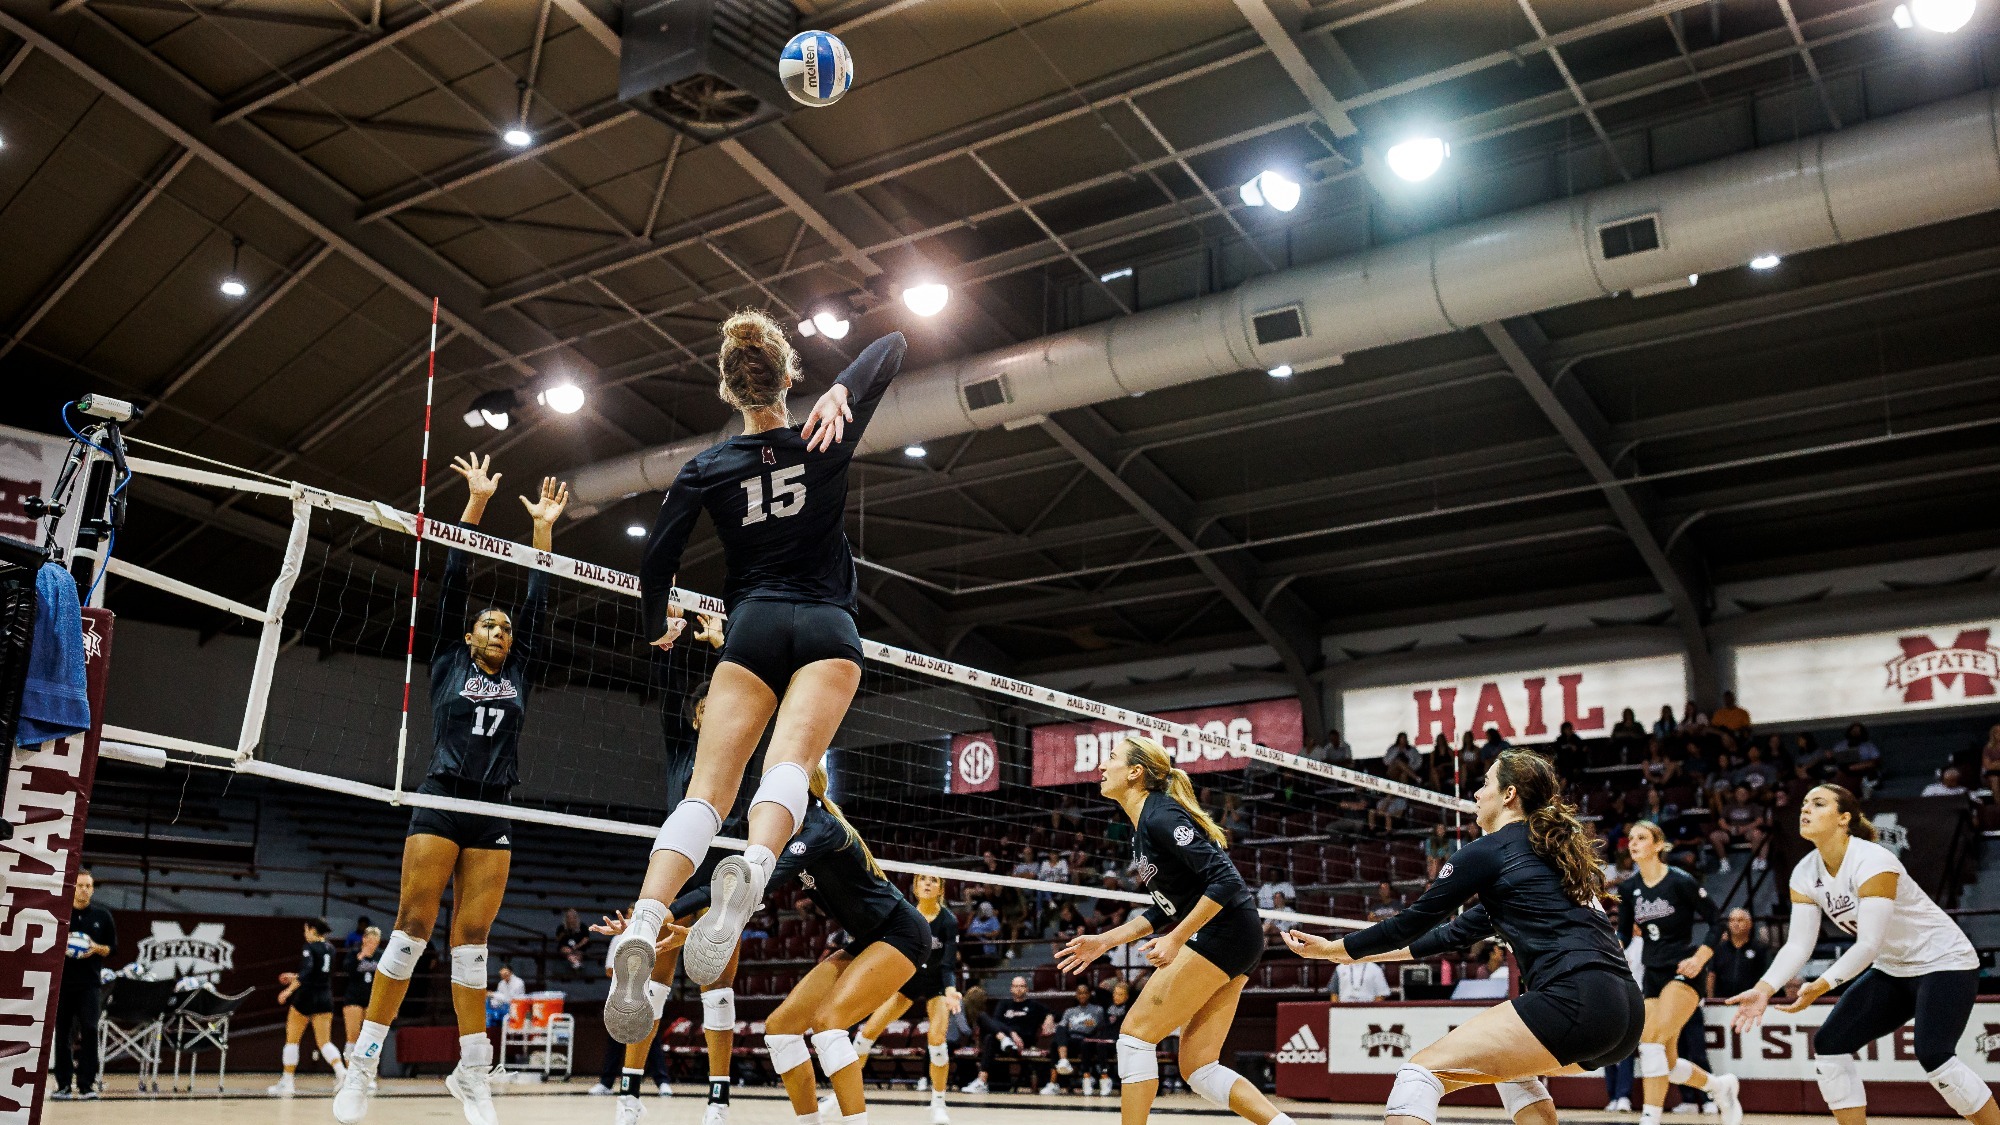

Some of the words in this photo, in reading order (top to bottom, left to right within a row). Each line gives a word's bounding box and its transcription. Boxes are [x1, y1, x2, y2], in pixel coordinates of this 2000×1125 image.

[806, 45, 818, 88] molten
[740, 463, 807, 527] 15
[429, 520, 466, 544] HAIL
[469, 532, 513, 558] STATE
[575, 560, 605, 582] HAIL
[699, 595, 726, 614] HAIL
[904, 651, 926, 667] HAIL
[927, 658, 954, 675] STATE
[1907, 652, 1986, 678] STATE
[990, 676, 1010, 690] HAIL
[1010, 682, 1034, 696] STATE
[1066, 696, 1085, 709] HAIL
[1085, 701, 1107, 716] STATE
[1413, 672, 1605, 746] HAIL
[471, 706, 505, 737] 17
[961, 743, 992, 781] SEC
[1647, 923, 1660, 941] 9
[154, 941, 217, 962] STATE
[0, 970, 52, 1125] AIL
[1277, 1048, 1327, 1064] adidas
